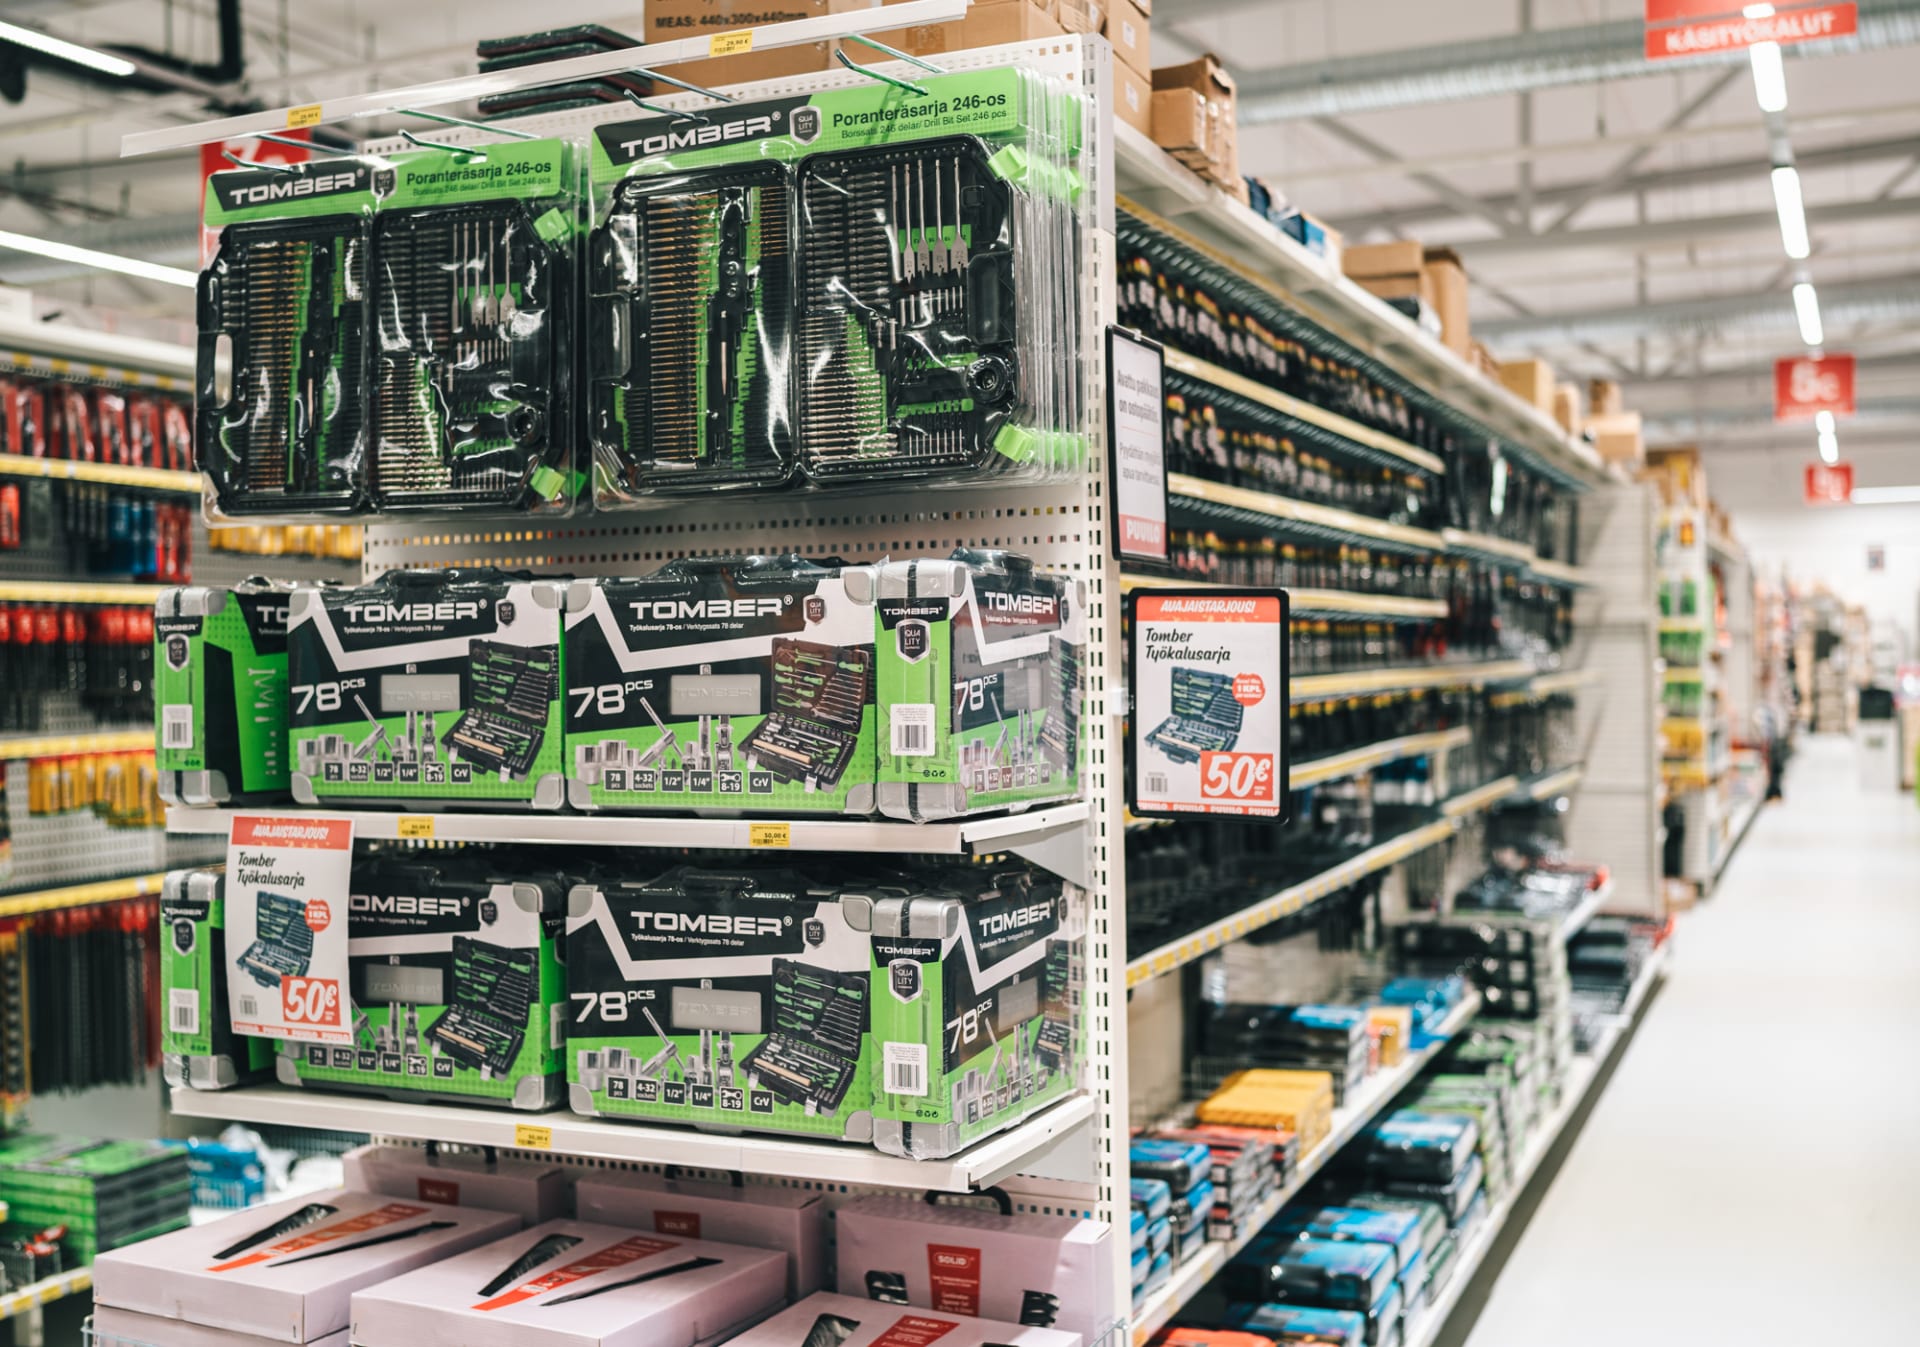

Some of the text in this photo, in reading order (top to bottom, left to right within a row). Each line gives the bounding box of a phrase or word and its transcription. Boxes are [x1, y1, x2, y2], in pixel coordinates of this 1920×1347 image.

[655, 16, 696, 28] MEAS:
[833, 93, 1006, 128] Poranteräsarja 246-os
[880, 124, 897, 134] 246
[924, 118, 941, 128] Drill
[942, 116, 954, 125] Bit
[956, 114, 971, 123] Set
[972, 112, 990, 121] 246
[991, 110, 1007, 120] pcs
[406, 162, 552, 186] Poranteräsarja 246-os
[905, 629, 920, 638] QUA
[1145, 627, 1193, 643] Tomber
[905, 637, 920, 646] LITY
[1145, 644, 1231, 664] Työkalusarja
[341, 677, 366, 692] pcs
[983, 673, 998, 689] pcs
[625, 679, 654, 695] pcs
[291, 681, 342, 715] 78
[569, 684, 625, 718] 78
[954, 678, 984, 715] 78
[328, 765, 339, 773] 78
[350, 765, 367, 774] 4-32
[453, 768, 468, 777] CrV
[610, 773, 621, 782] 78
[634, 773, 653, 783] 4-32
[664, 776, 681, 786] 1/2"
[692, 776, 710, 786] 1/4"
[752, 777, 769, 787] CrV
[721, 782, 741, 792] 8-19
[238, 851, 277, 867] Tomber
[237, 868, 305, 890] Työkalusarja
[898, 969, 913, 977] QUA
[898, 976, 912, 985] LITY
[628, 989, 656, 1004] pcs
[570, 991, 628, 1023] 78
[977, 998, 993, 1016] pcs
[946, 1007, 978, 1054] 78
[436, 1063, 451, 1073] CrV
[612, 1081, 624, 1089] 78
[636, 1082, 656, 1092] 4-32
[666, 1088, 684, 1098] 1/2"
[694, 1091, 712, 1101] 1/4"
[722, 1099, 742, 1109] 8-19
[753, 1097, 770, 1107] CrV
[938, 1255, 968, 1266] SOLID
